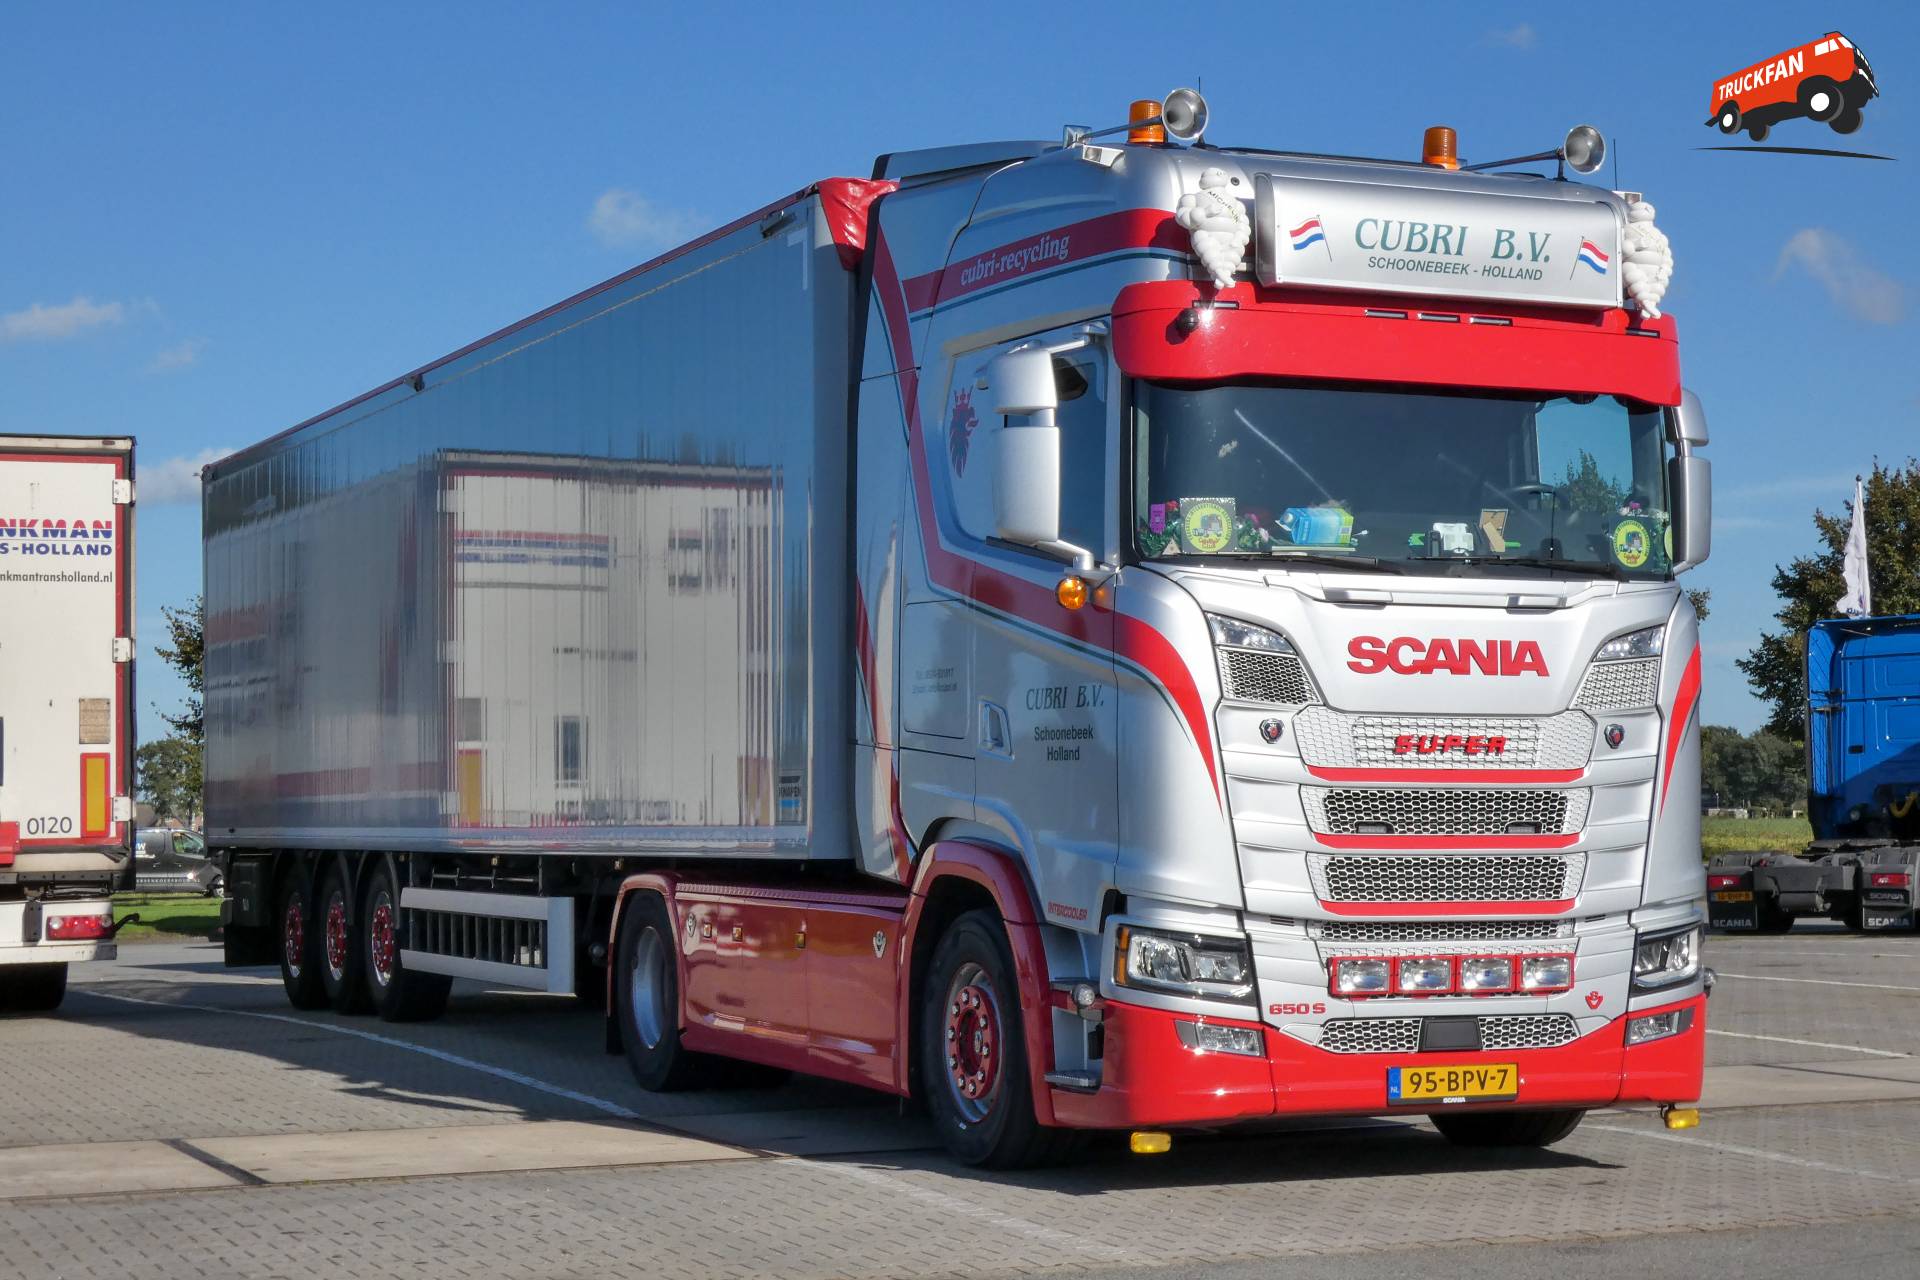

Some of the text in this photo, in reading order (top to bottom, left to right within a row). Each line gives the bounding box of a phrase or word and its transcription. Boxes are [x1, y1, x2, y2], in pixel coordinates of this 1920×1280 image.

[1207, 191, 1241, 223] MICHELIN
[1355, 218, 1551, 263] CUBRI B.V.
[961, 235, 1070, 285] cubri-recycling
[1368, 256, 1470, 275] SCHOONEBEEK
[1481, 265, 1543, 281] HOLLAND
[1347, 635, 1550, 677] SCANIA
[1026, 684, 1104, 711] CUBRI B.V.
[1034, 724, 1094, 741] Schoonebeek
[1047, 746, 1080, 761] Holland
[1393, 734, 1507, 756] SUPER
[27, 816, 72, 835] 0120
[1712, 919, 1752, 928] SCANIA
[1868, 917, 1910, 927] SCANIA
[1269, 1002, 1327, 1015] 650 S
[1409, 1068, 1509, 1094] 95-BPV-7
